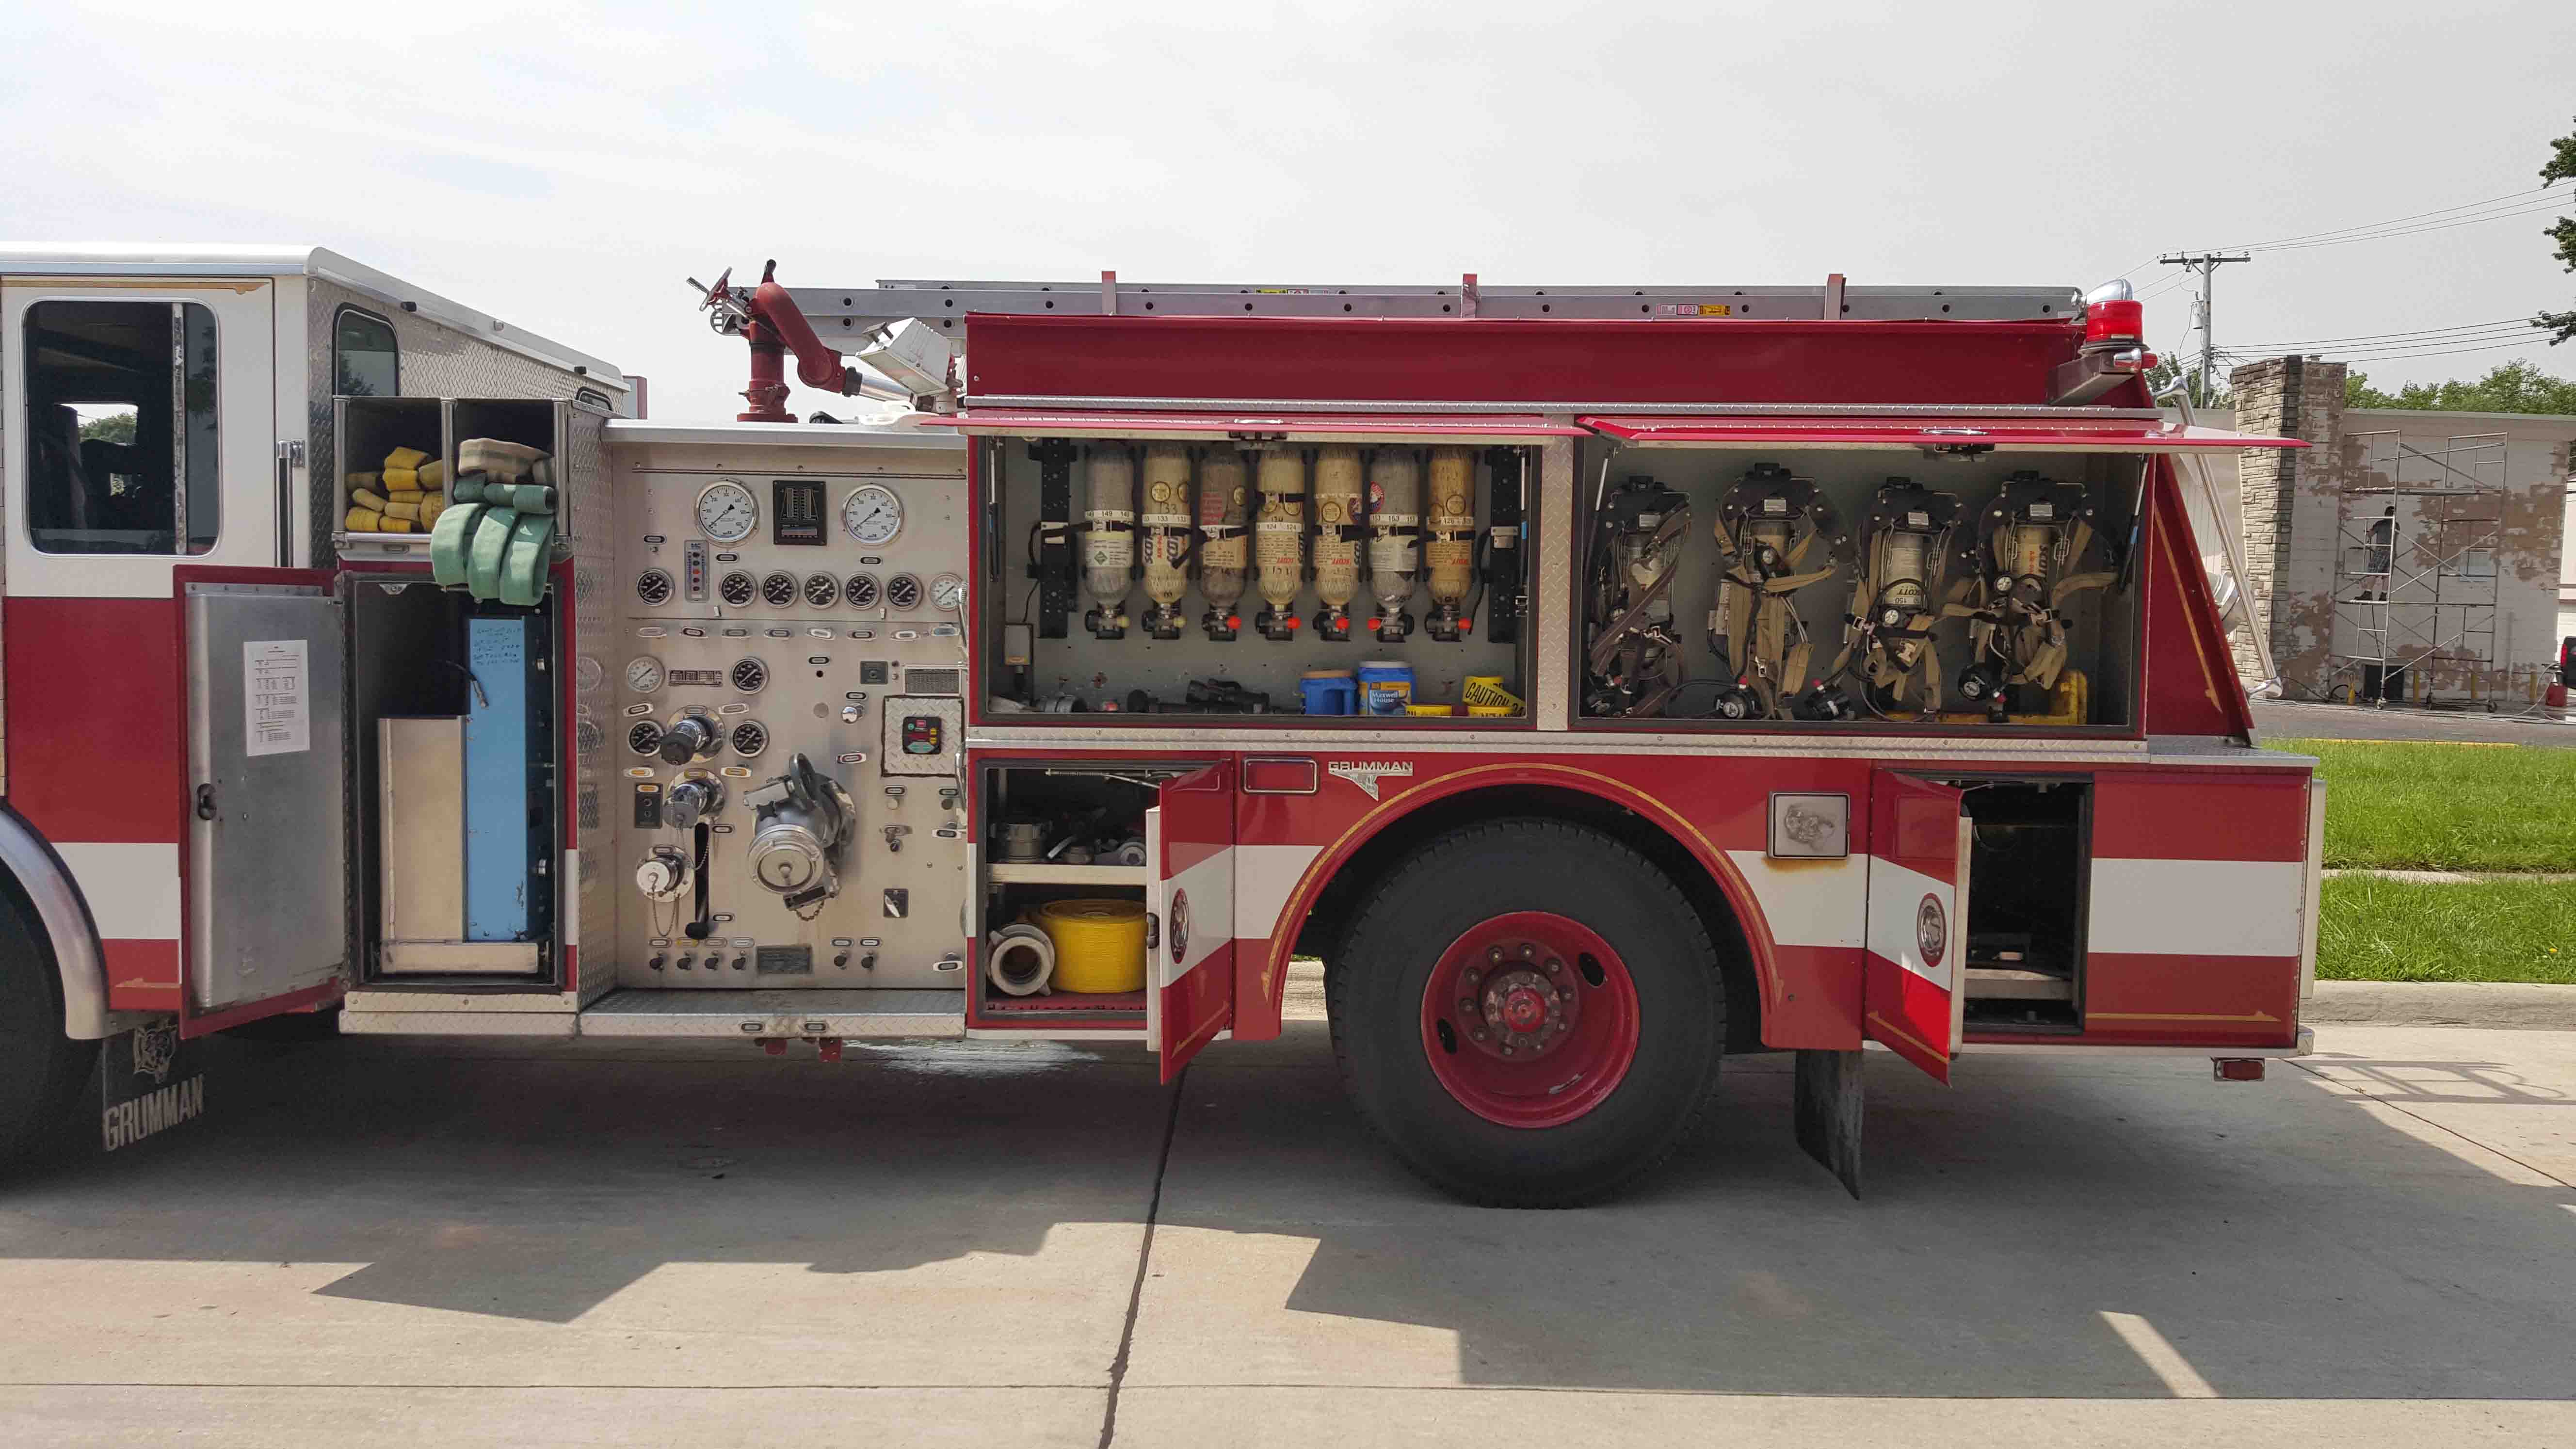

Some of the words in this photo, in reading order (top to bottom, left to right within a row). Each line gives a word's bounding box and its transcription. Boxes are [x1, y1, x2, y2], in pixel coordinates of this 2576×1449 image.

[1144, 535, 1154, 564] SCOT
[1465, 682, 1510, 706] CAUTION
[1328, 761, 1413, 772] GRUMMAN
[103, 1074, 204, 1152] GRUMMAN
